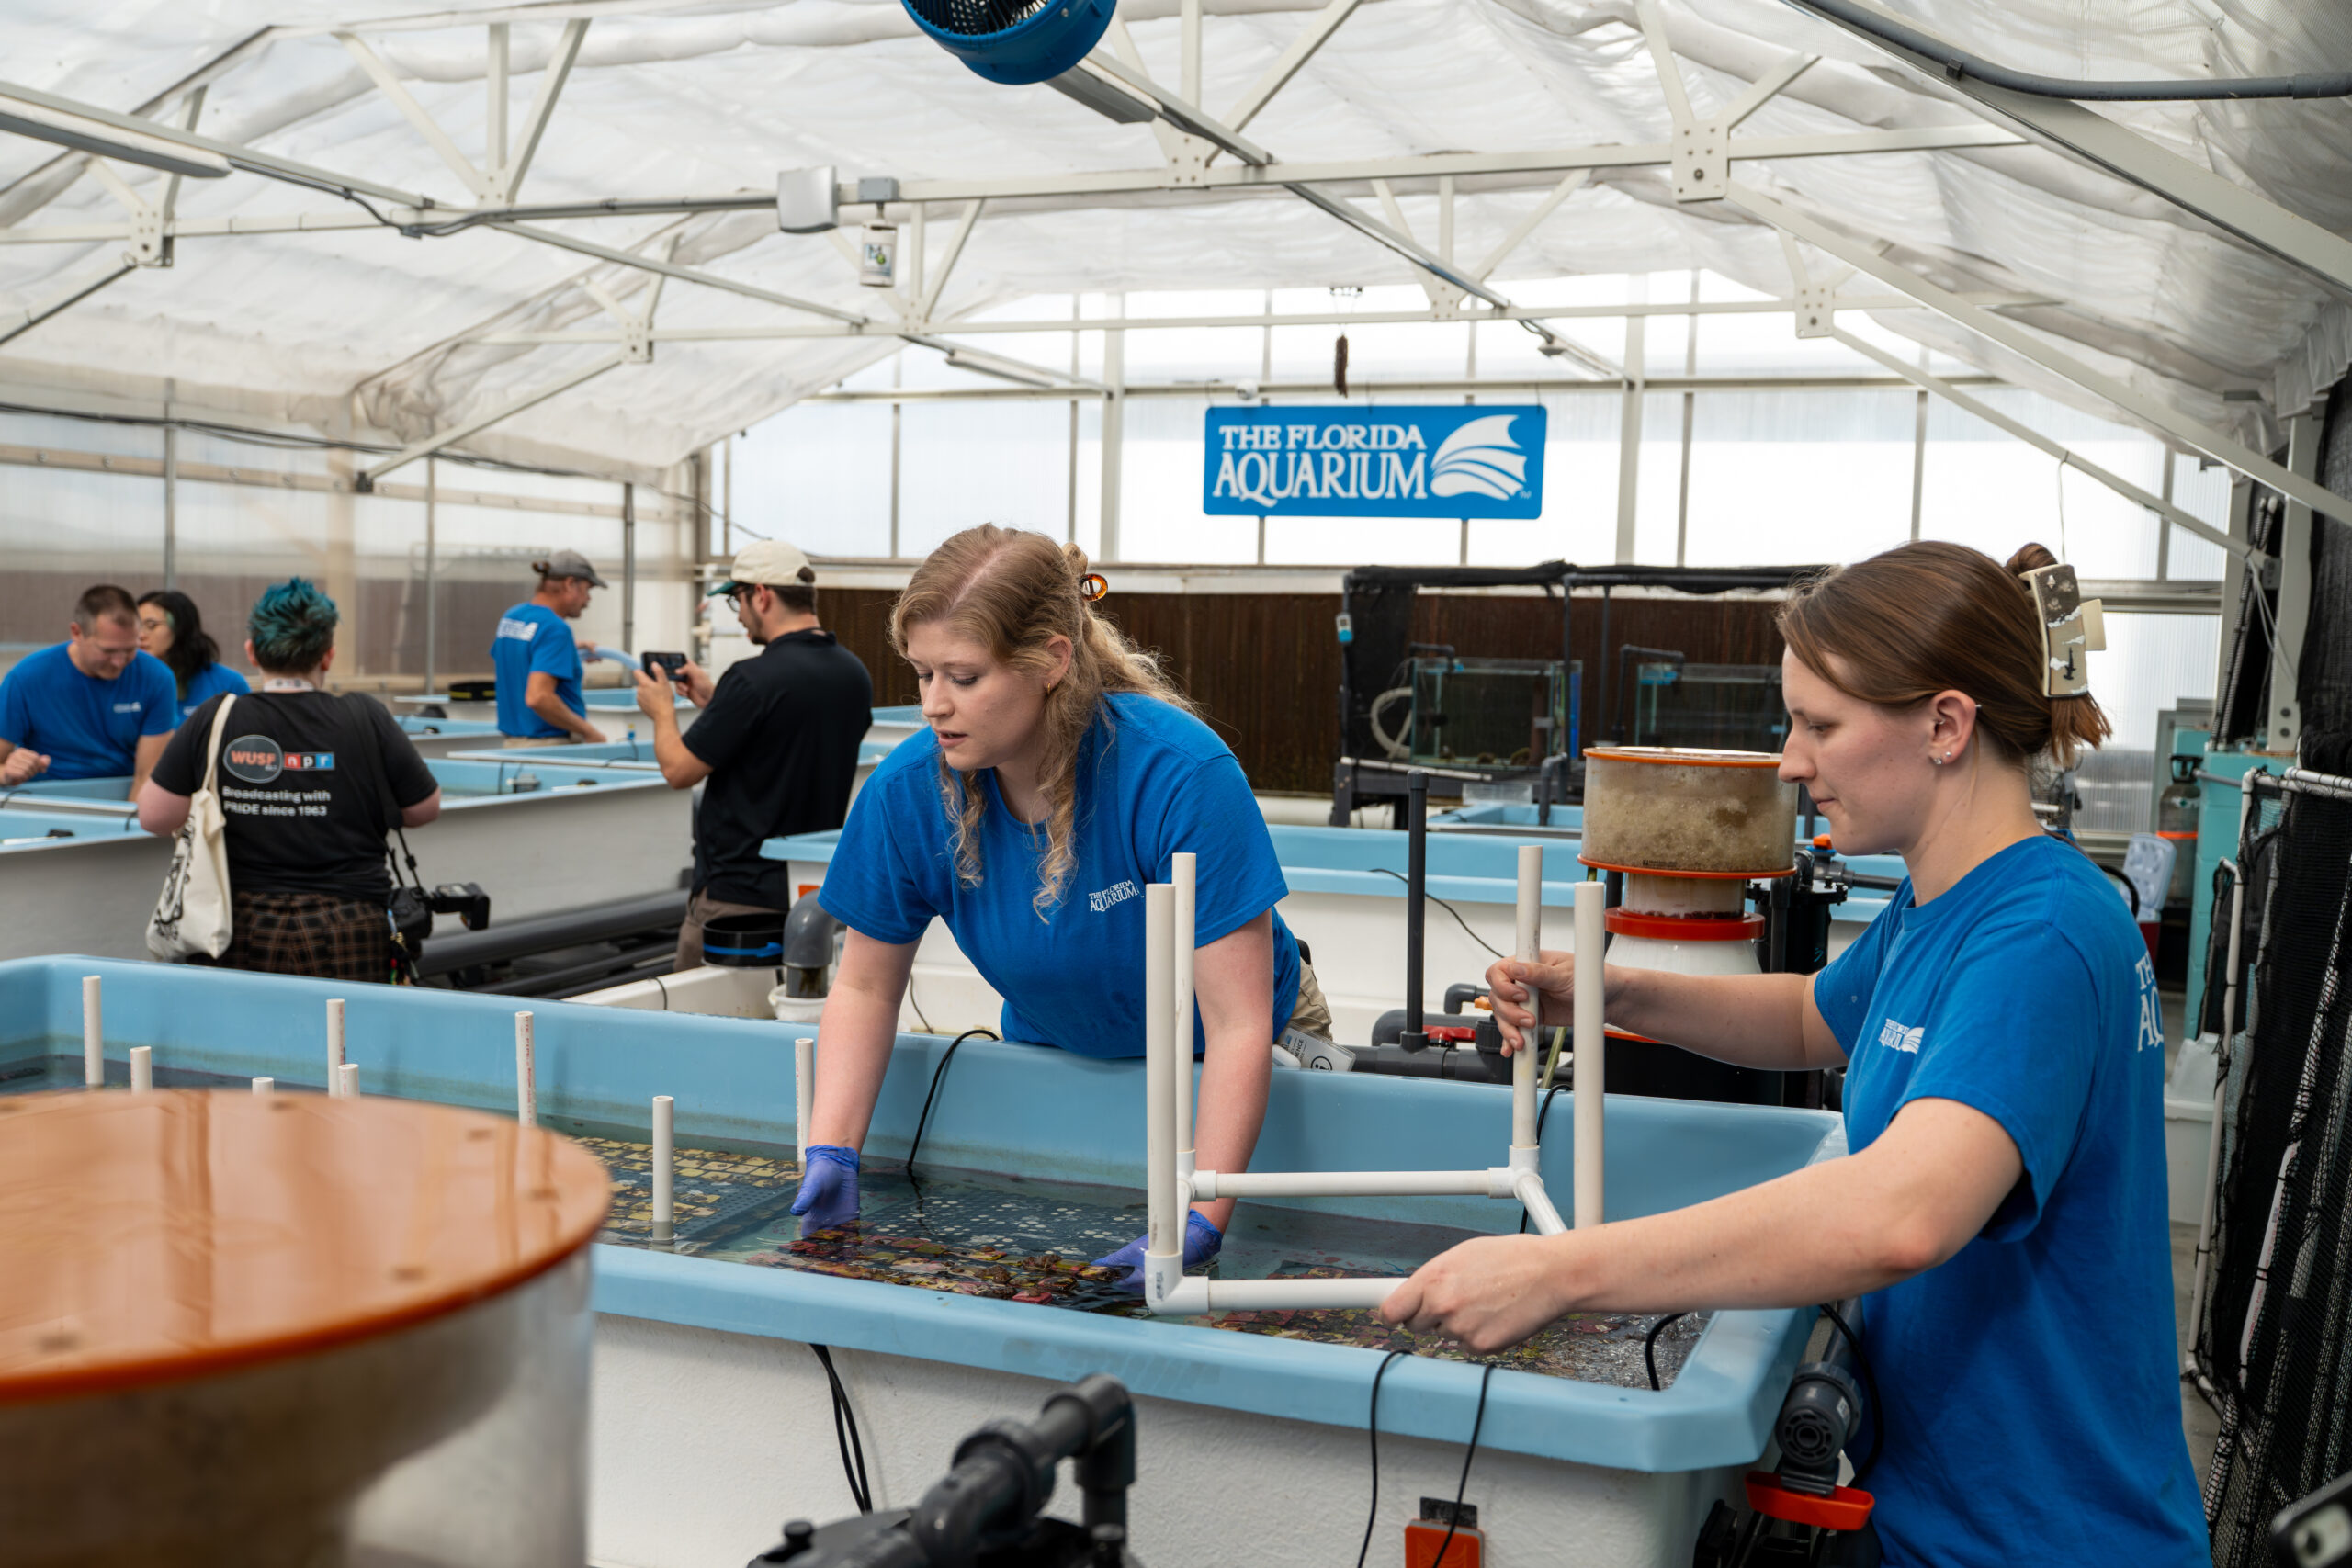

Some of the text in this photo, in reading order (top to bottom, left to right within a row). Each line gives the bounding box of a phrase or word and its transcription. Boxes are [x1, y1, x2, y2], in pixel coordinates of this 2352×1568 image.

[1218, 424, 1427, 450] THE FLORIDA
[1212, 452, 1428, 508] AQUARIUM
[231, 750, 276, 766] WUSF
[287, 754, 330, 769] npr
[222, 785, 331, 804] Broadcasting with
[223, 800, 260, 815] PRIDE
[261, 804, 296, 817] since
[1088, 879, 1134, 899] THE FLORIDA
[1090, 885, 1138, 912] AQUARIUM
